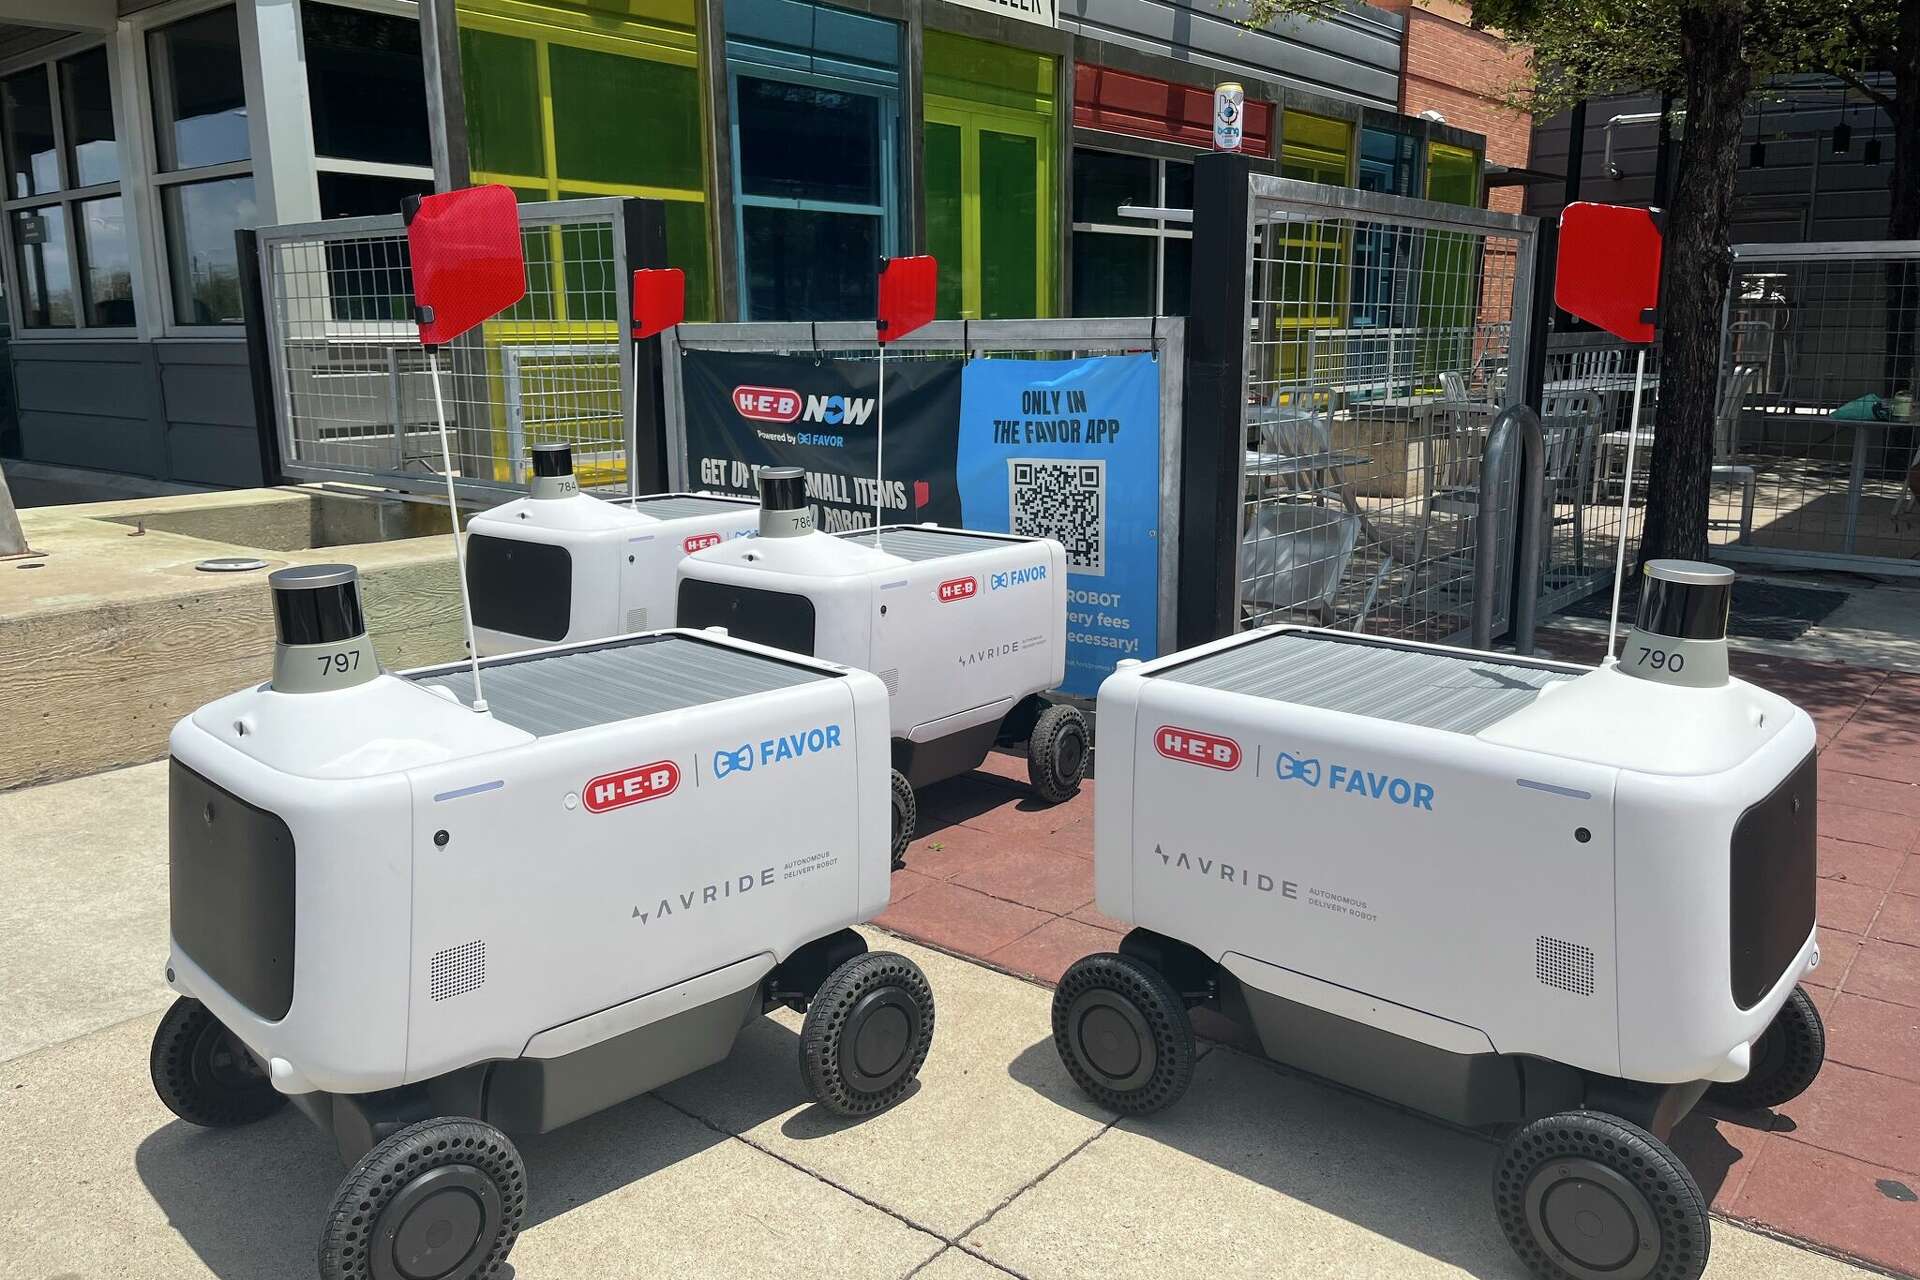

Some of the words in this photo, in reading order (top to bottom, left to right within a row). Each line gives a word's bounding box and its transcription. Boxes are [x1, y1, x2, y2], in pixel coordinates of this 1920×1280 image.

[802, 394, 875, 425] NOW
[1022, 390, 1061, 415] ONLY
[1066, 390, 1087, 413] IN
[757, 429, 786, 442] Powered
[786, 433, 796, 445] by
[812, 434, 844, 448] FAVOR
[993, 419, 1020, 444] THE
[1025, 419, 1081, 444] FAVOR
[1085, 419, 1120, 444] APP
[701, 457, 727, 486] GET
[731, 460, 750, 489] UP
[558, 481, 576, 493] 784
[853, 477, 907, 510] ITEMS
[792, 515, 811, 530] 786
[1010, 565, 1047, 586] FAVOR
[1066, 589, 1121, 608] ROBOT
[1097, 612, 1131, 630] fees
[968, 641, 1019, 665] AVRIDE
[1066, 631, 1139, 653] ecessary!
[318, 650, 360, 676] 797
[1637, 647, 1685, 673] 790
[594, 769, 670, 804] H-E-B
[760, 724, 841, 766] FAVOR
[1164, 734, 1232, 763] H-E-B
[1328, 764, 1435, 811] FAVOR
[1176, 852, 1299, 900] AVRIDE
[656, 867, 775, 919] AVRIDE
[1309, 887, 1368, 909] AUTONOMOUS
[1308, 898, 1347, 914] DELIVERY
[1349, 908, 1377, 922] ROBOT
